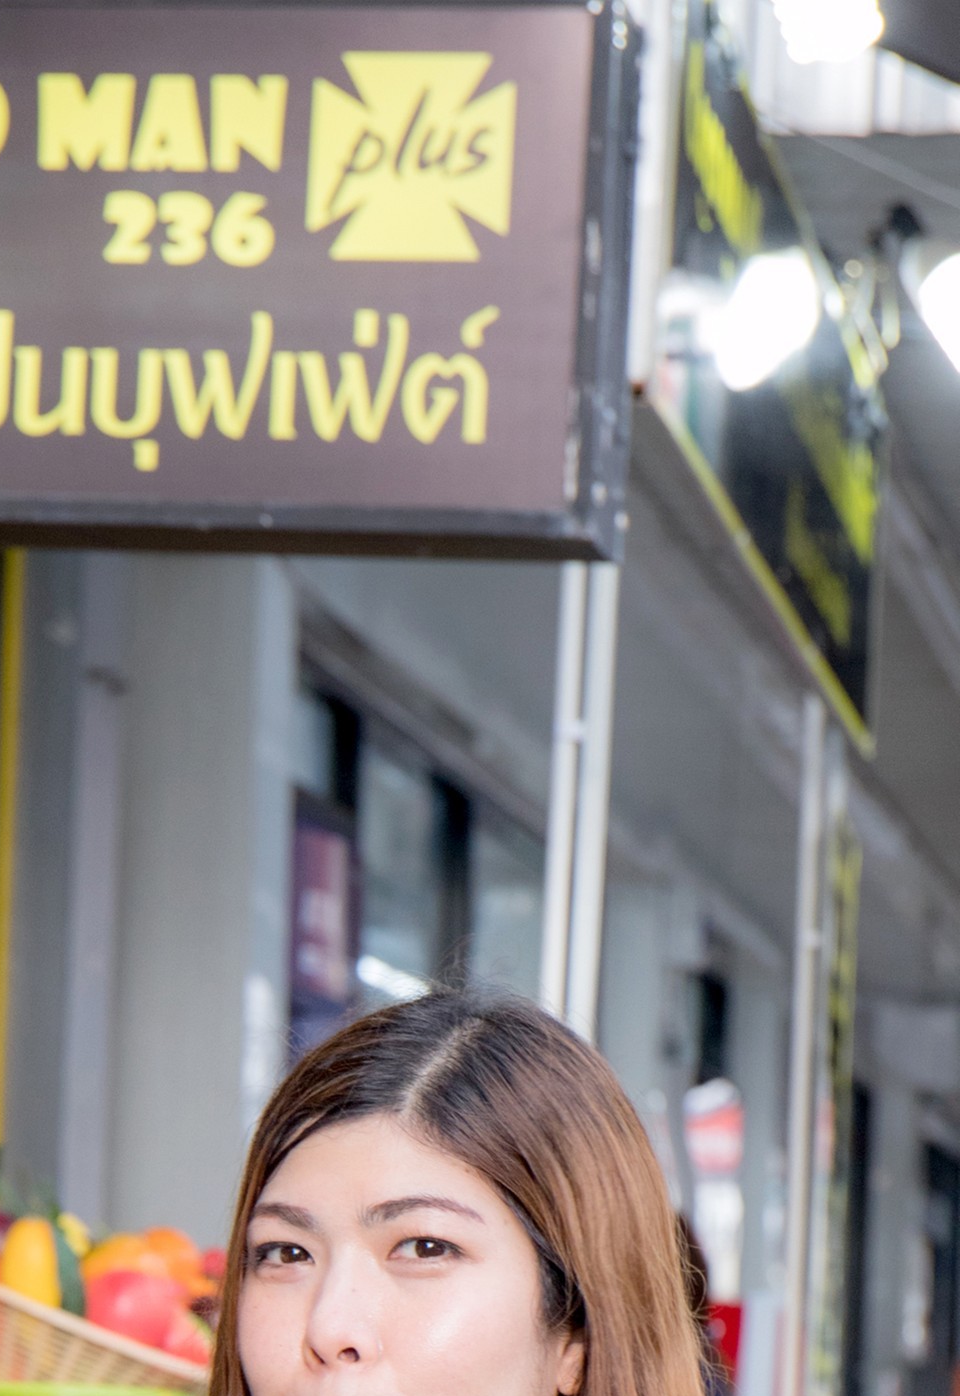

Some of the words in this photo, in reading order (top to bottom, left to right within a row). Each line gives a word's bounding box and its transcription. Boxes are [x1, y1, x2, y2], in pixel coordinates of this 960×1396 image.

[38, 73, 288, 173] MAN
[328, 84, 492, 212] plus
[103, 190, 276, 267] 236
